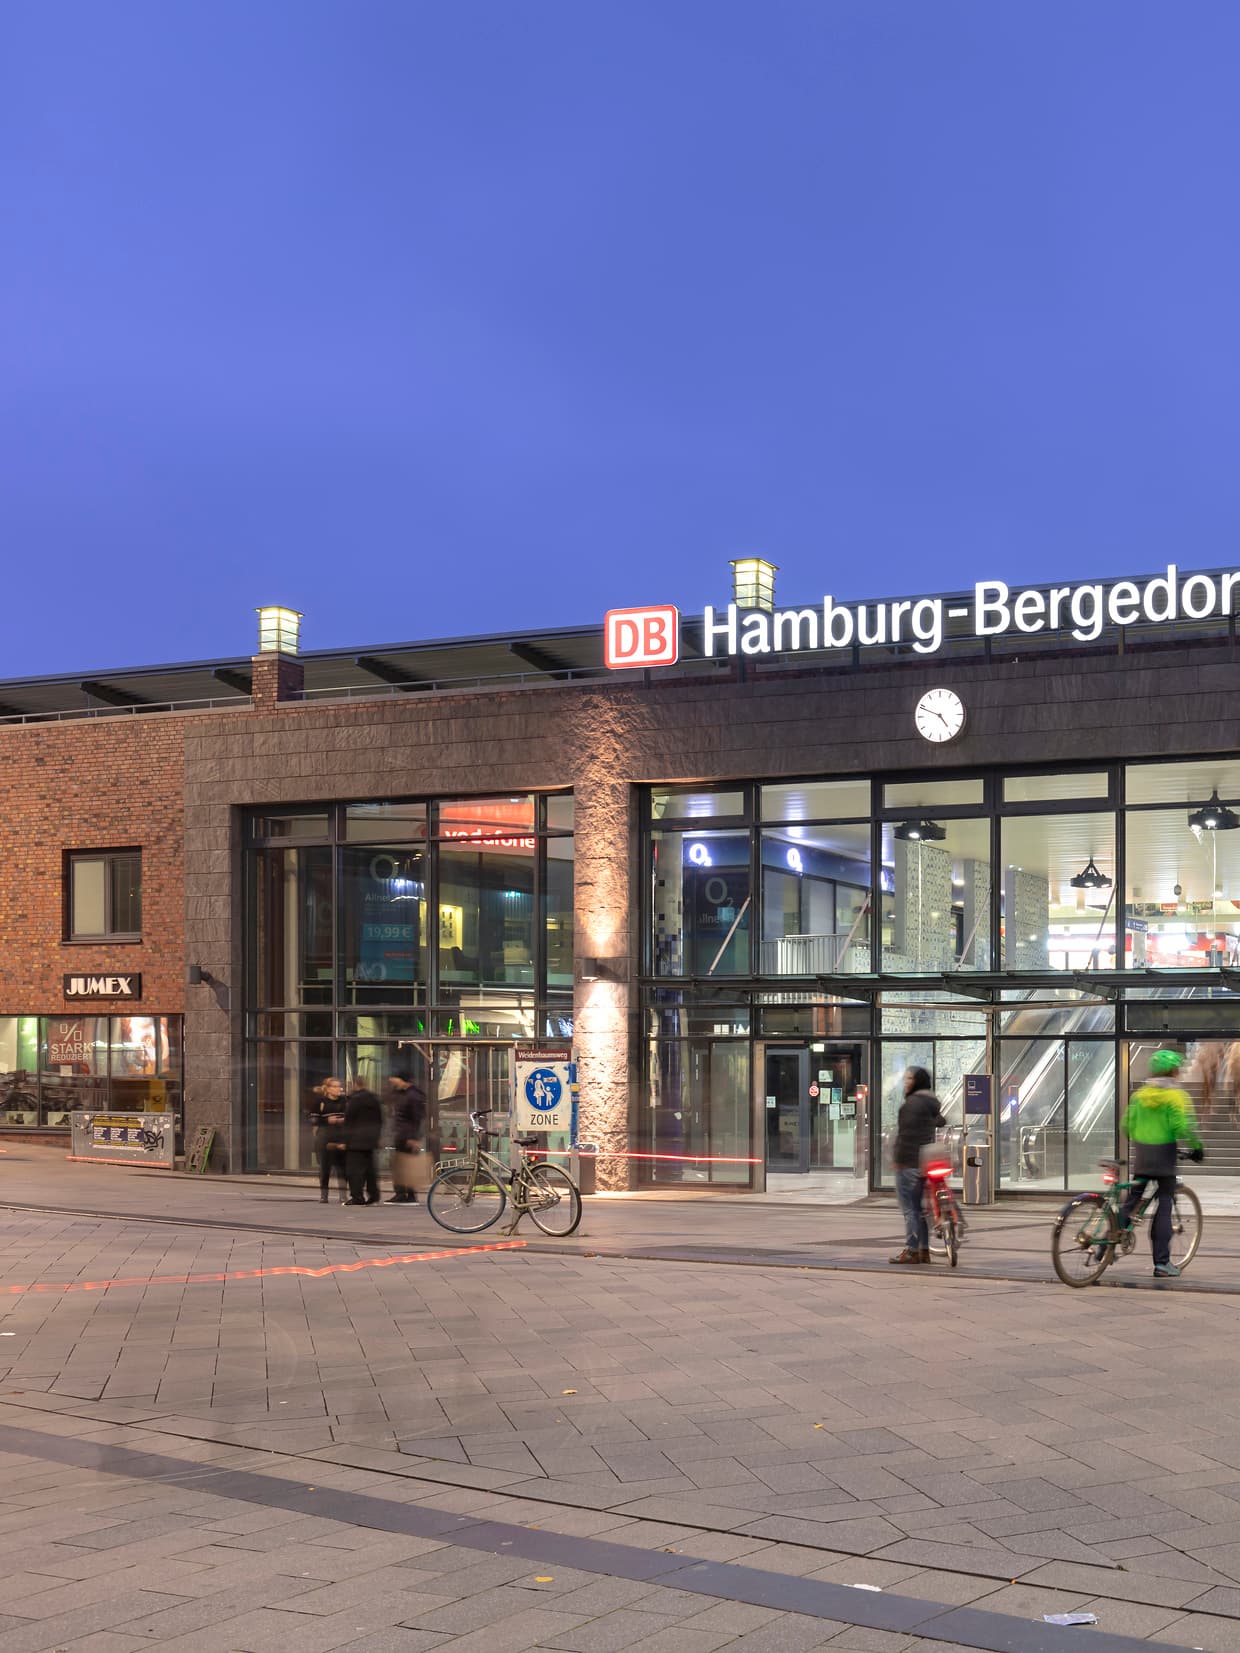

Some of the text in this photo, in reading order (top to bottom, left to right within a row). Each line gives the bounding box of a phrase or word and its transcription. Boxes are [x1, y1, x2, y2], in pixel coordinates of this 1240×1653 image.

[614, 616, 668, 659] DB
[66, 977, 132, 995] JUMEX
[51, 1042, 92, 1055] STARK
[530, 1114, 559, 1125] ZONE
